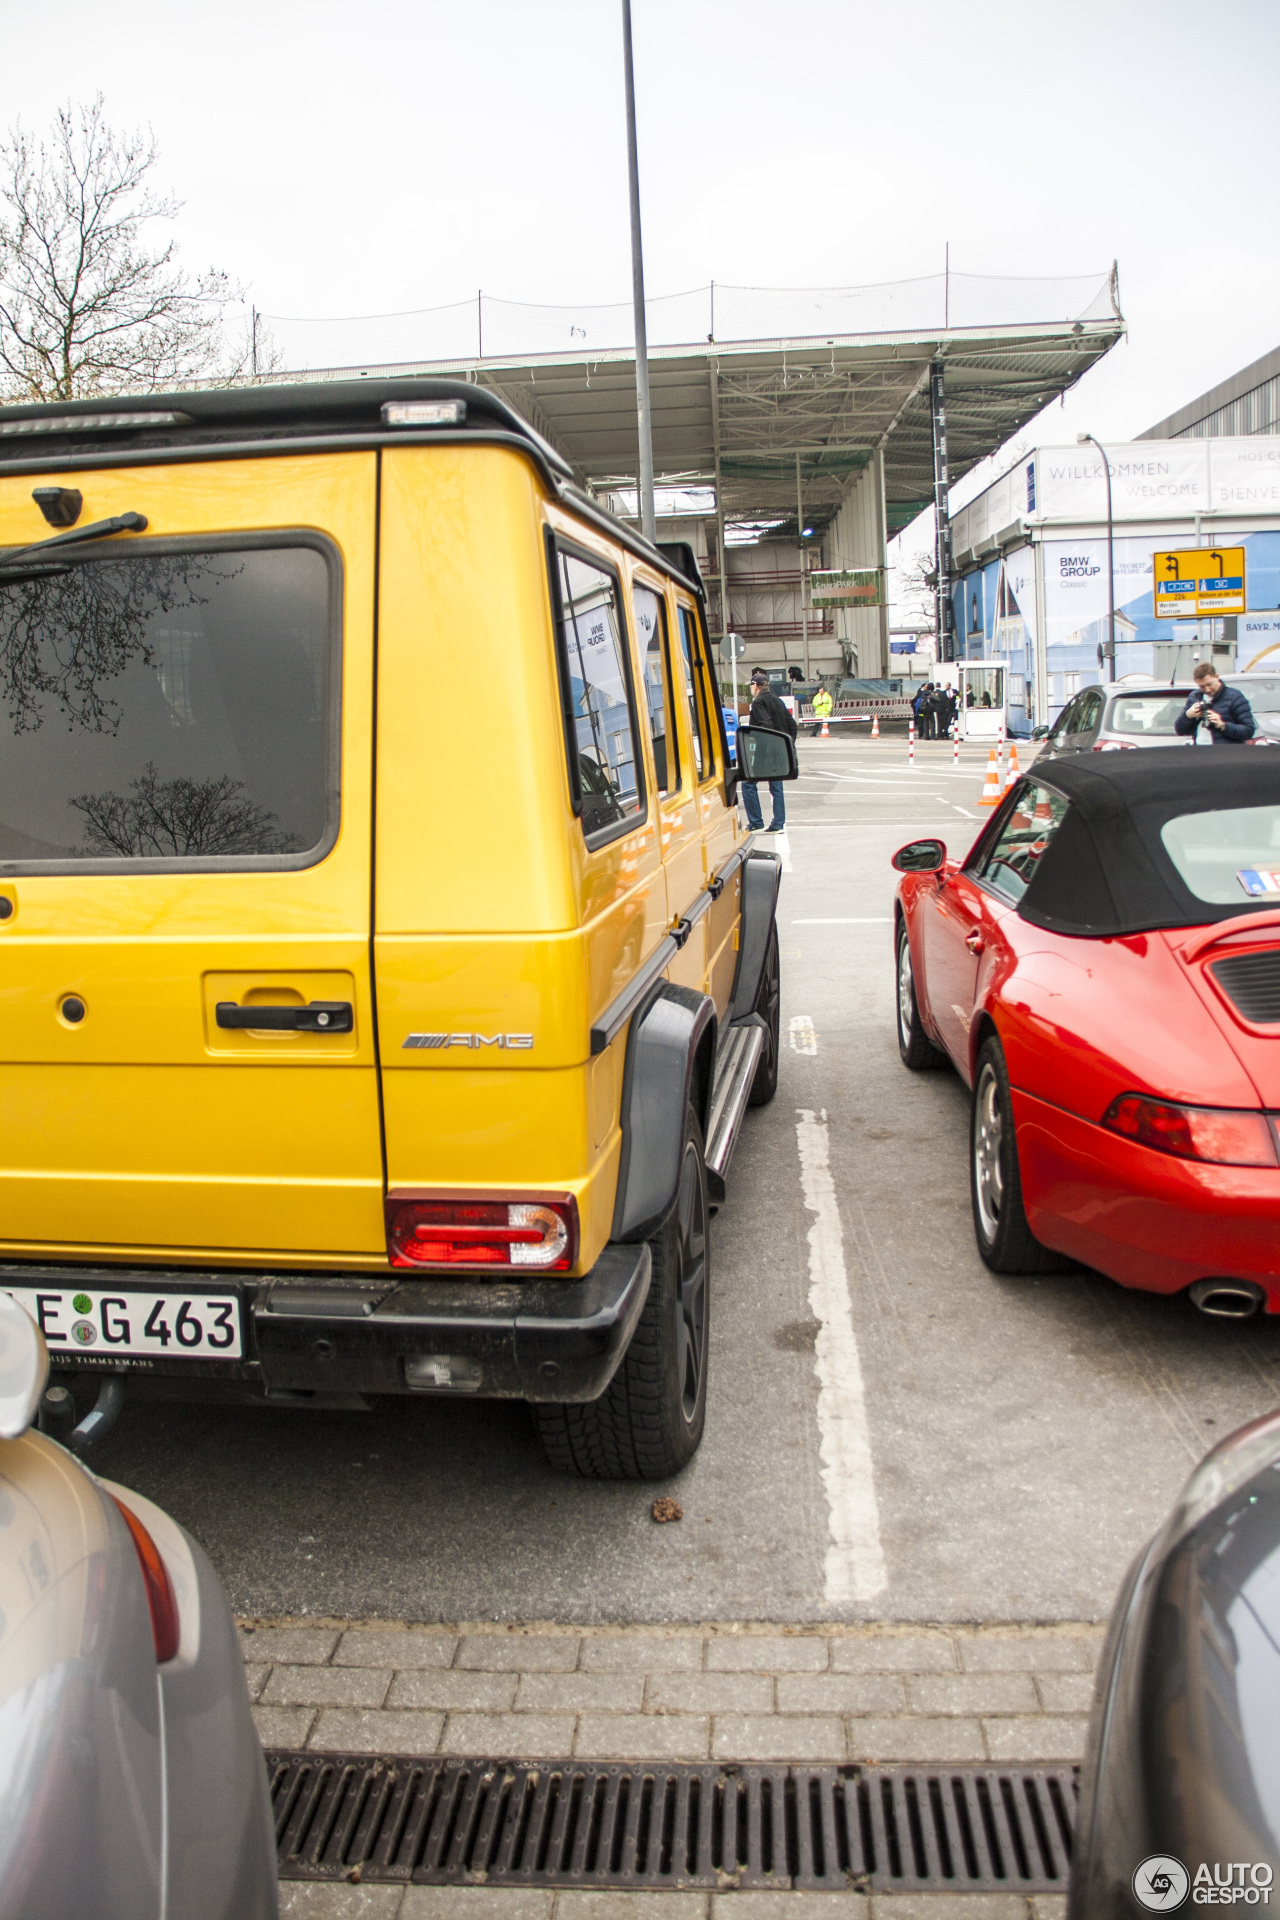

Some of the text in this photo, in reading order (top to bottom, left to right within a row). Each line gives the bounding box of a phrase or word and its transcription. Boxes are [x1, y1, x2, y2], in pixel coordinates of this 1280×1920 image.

[1048, 462, 1170, 479] WILLKOMMEN
[1126, 484, 1200, 498] WELCOME
[1060, 556, 1090, 567] BMW
[1060, 566, 1100, 578] GROUP
[816, 580, 858, 590] GrugaPARK
[1060, 580, 1087, 588] Classic
[442, 1034, 533, 1048] AMG
[100, 1298, 131, 1344] G
[144, 1300, 235, 1348] 463
[75, 1356, 154, 1367] TIMMERMANS
